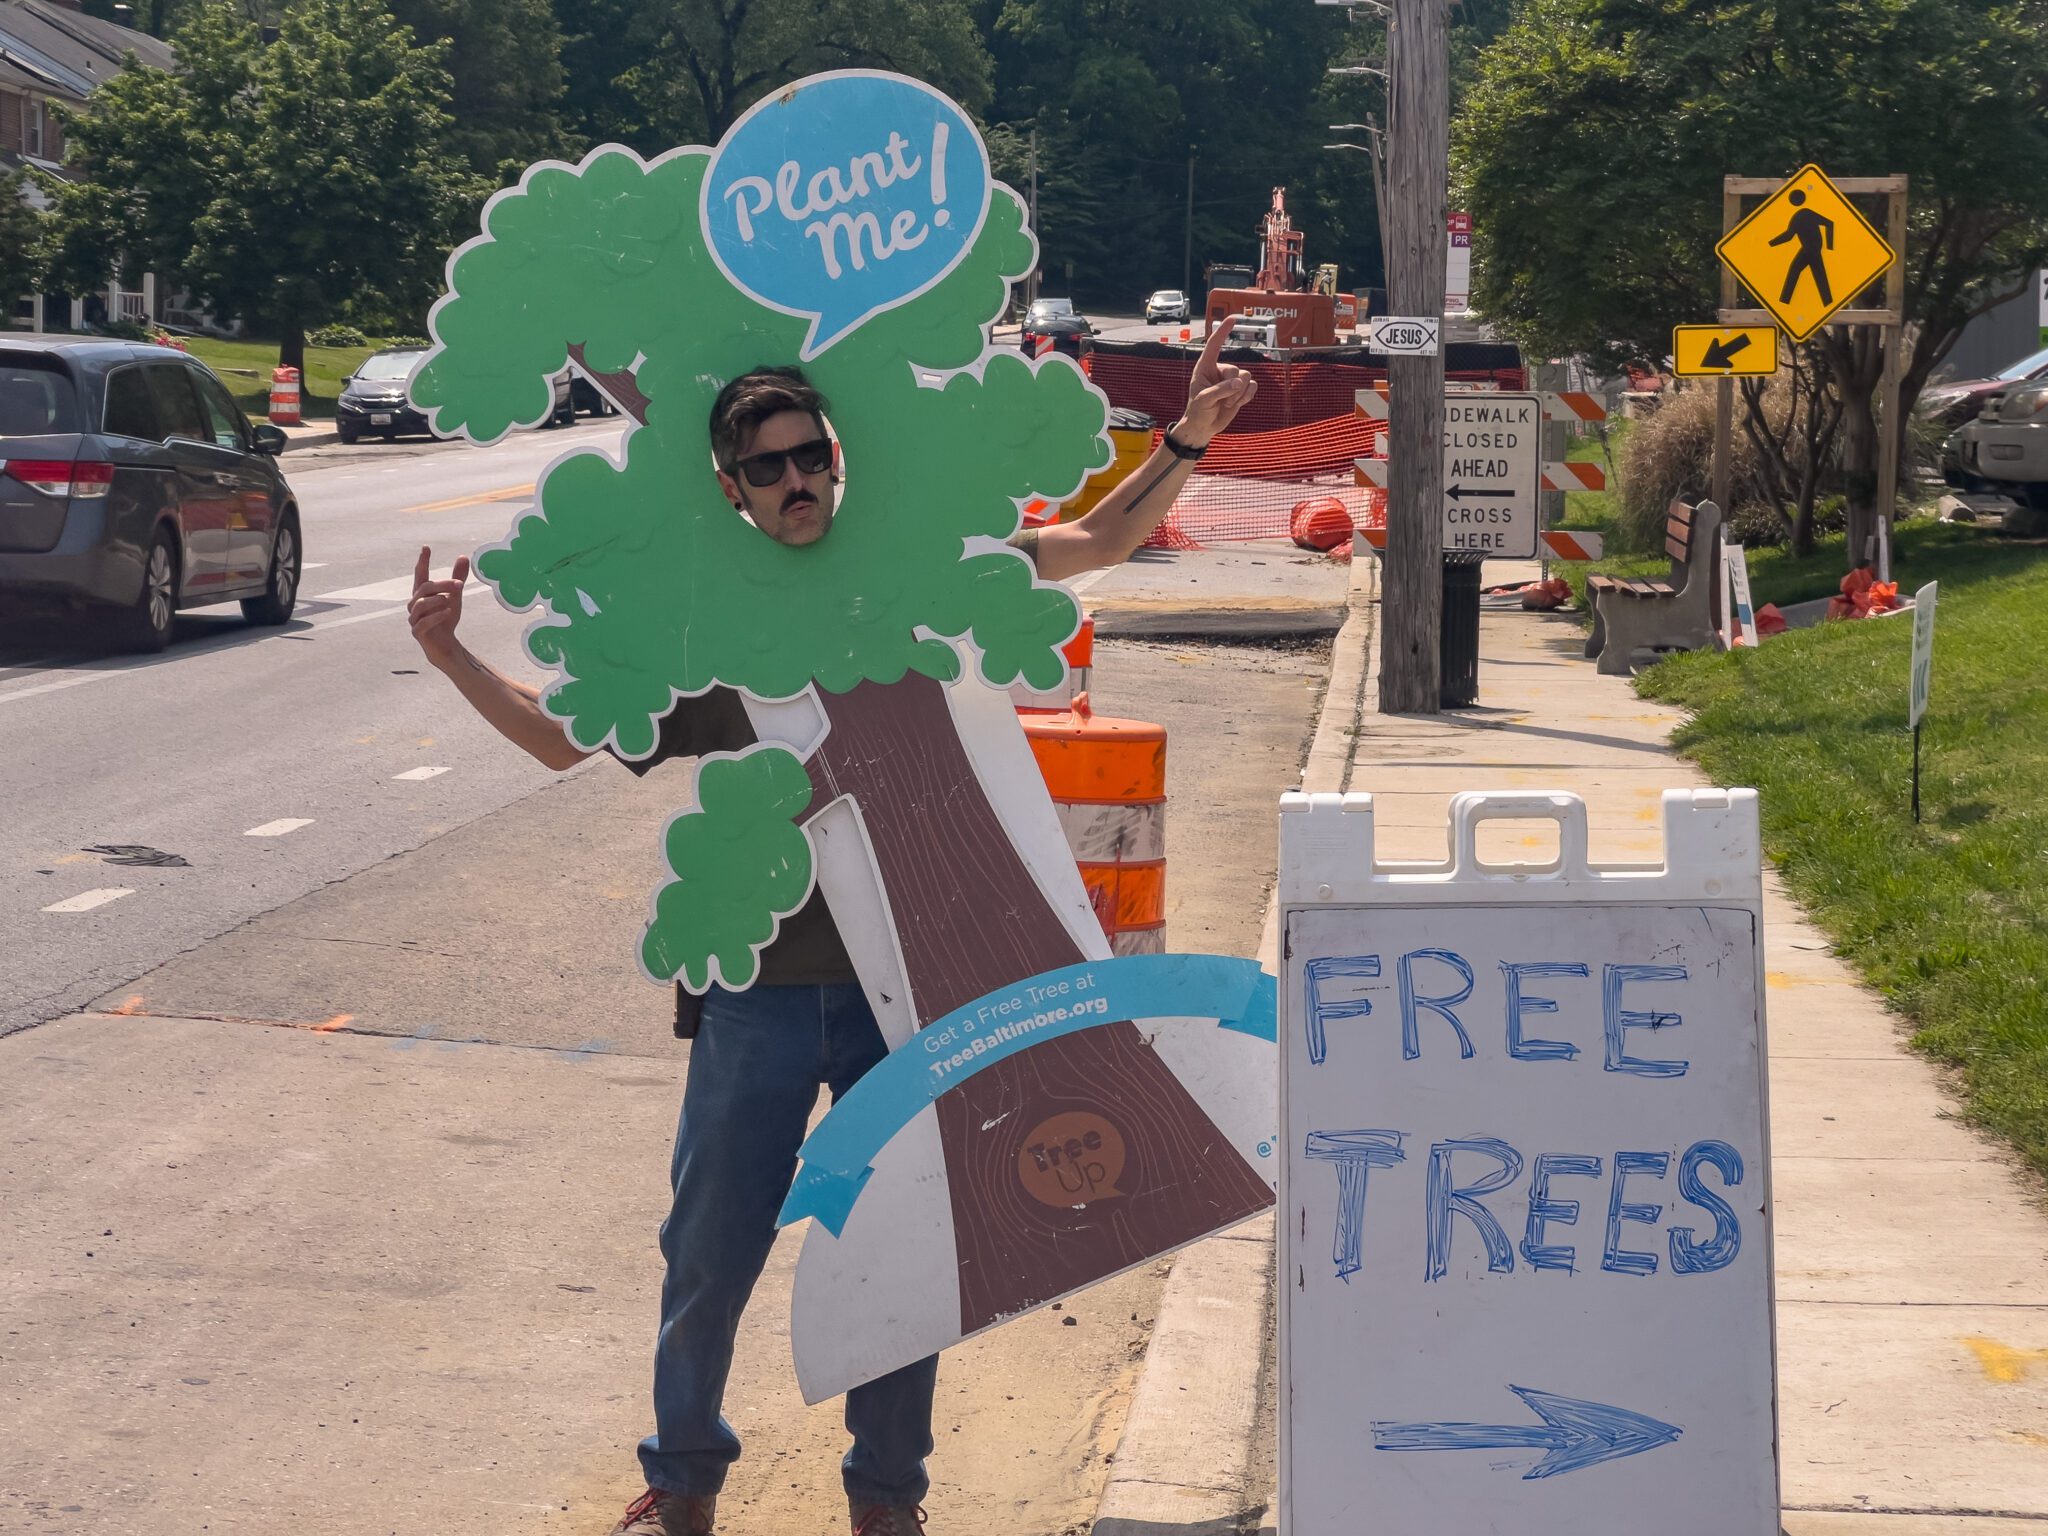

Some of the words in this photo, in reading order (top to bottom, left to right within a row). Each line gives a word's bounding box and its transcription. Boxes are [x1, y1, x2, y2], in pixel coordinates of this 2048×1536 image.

[724, 131, 922, 242] Plant
[1455, 235, 1468, 245] PR
[1243, 306, 1297, 319] HITACHI
[1385, 328, 1422, 344] JESUS
[1444, 407, 1529, 423] IDEWALK
[1444, 432, 1518, 449] CLOSED
[1450, 459, 1508, 478] AHEAD
[1447, 508, 1512, 523] CROSS
[1454, 533, 1505, 548] HERE
[924, 1026, 960, 1053] Get
[962, 1018, 976, 1033] a
[977, 997, 1023, 1025] Free
[1025, 981, 1070, 1004] Tree
[1076, 972, 1096, 991] at
[1303, 947, 1691, 1078] FREE
[928, 996, 1109, 1079] TreeBaltimore.org
[1056, 1160, 1106, 1194] Up
[1304, 1131, 1744, 1285] TREES
